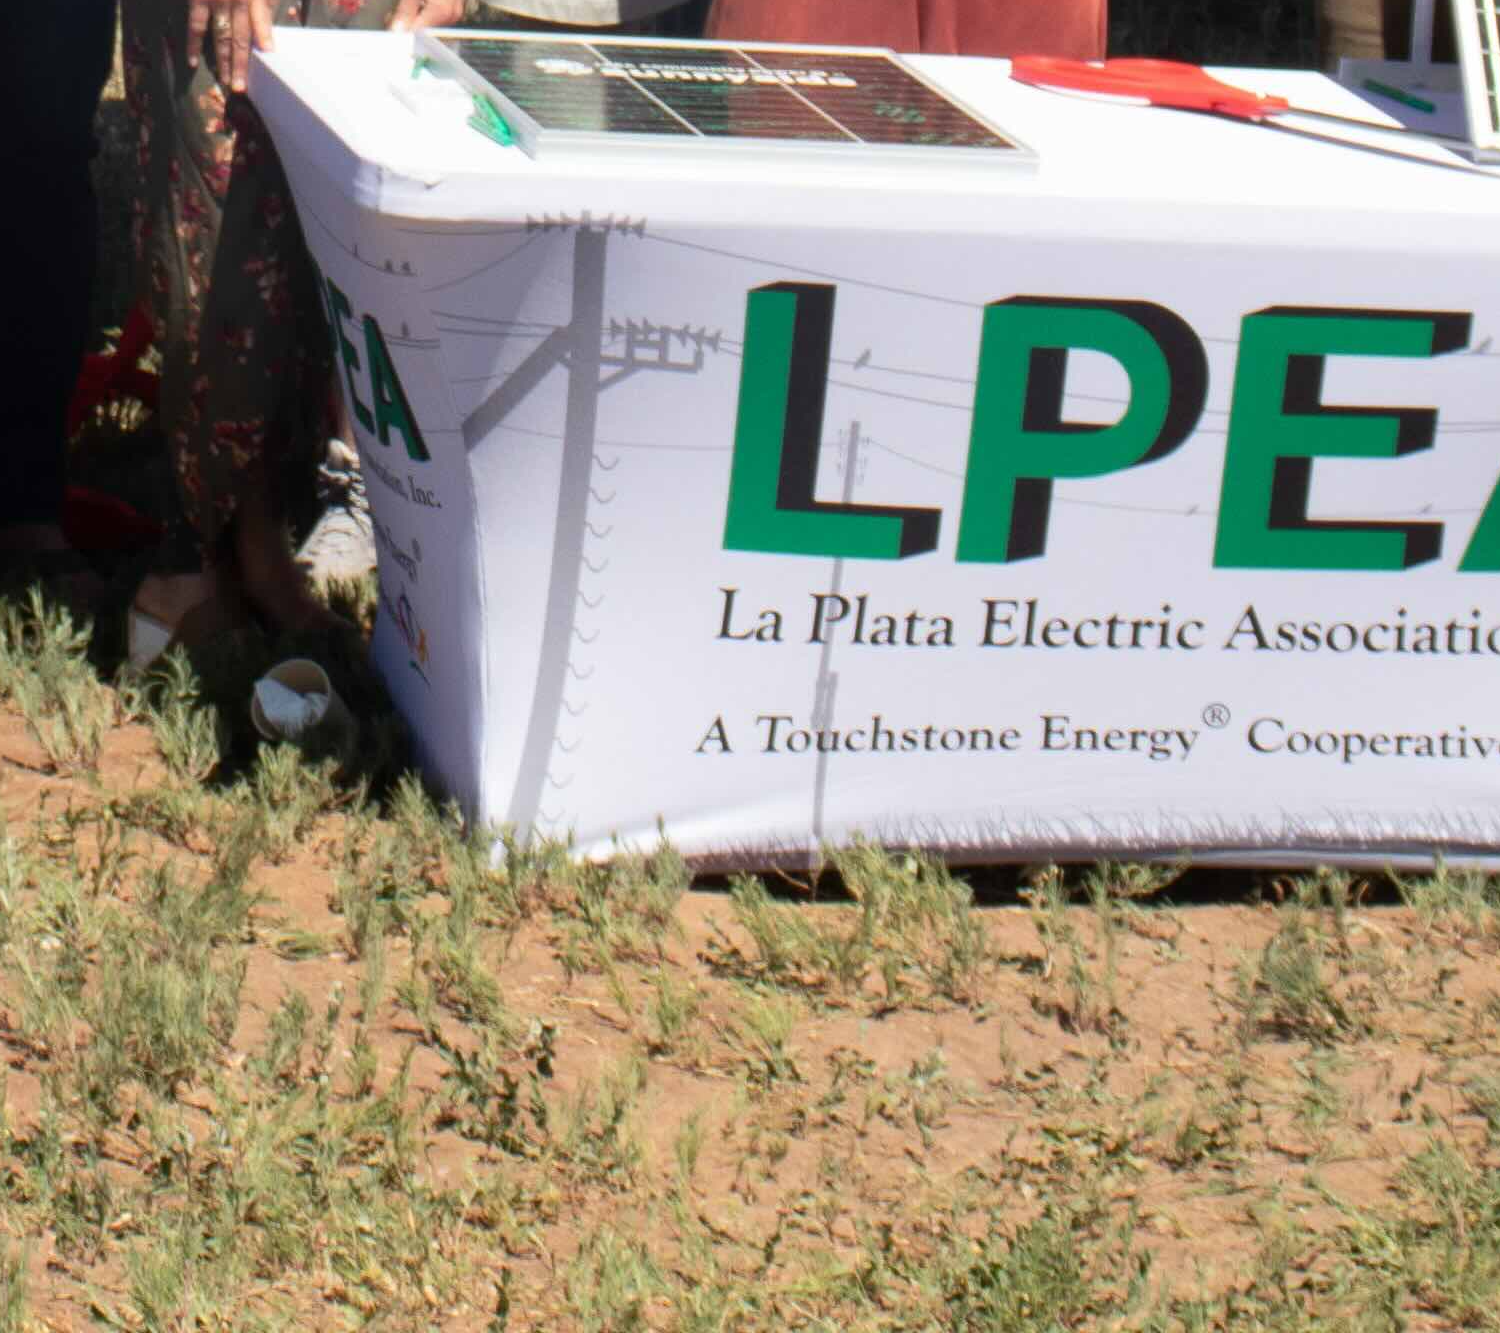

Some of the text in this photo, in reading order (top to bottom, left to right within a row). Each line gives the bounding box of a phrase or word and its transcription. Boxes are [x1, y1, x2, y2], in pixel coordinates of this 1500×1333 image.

[319, 276, 431, 462] EA
[717, 586, 785, 643] La
[806, 591, 957, 649] Plata
[979, 596, 1206, 651] Electric
[694, 713, 735, 754] A
[756, 713, 1021, 754] Touchstone
